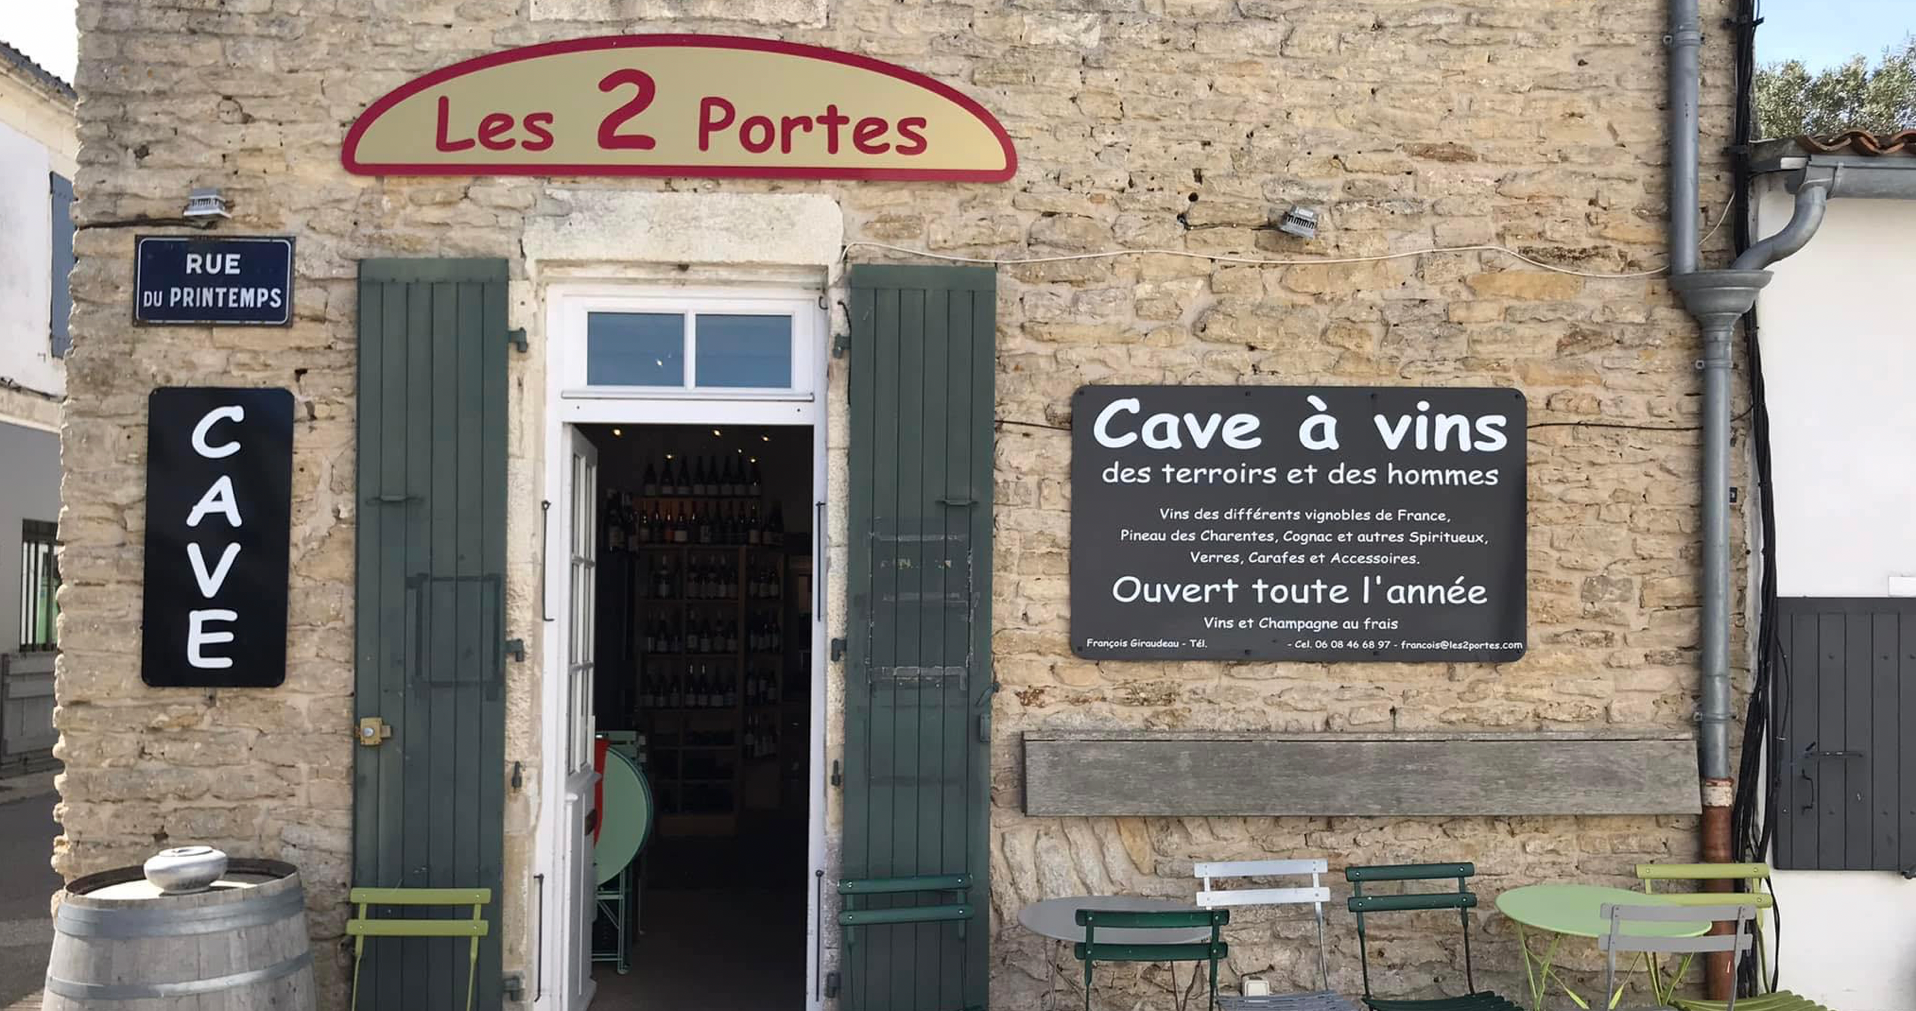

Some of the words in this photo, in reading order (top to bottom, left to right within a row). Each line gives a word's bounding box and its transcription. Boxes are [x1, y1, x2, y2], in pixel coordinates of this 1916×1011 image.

[435, 95, 554, 153] Les
[597, 68, 657, 151] 2
[698, 96, 928, 156] Portes
[186, 253, 241, 275] RUE
[143, 291, 163, 307] DU
[170, 287, 282, 308] PRINTEMPS
[1093, 397, 1262, 450] Cave
[1298, 394, 1340, 451] à
[1373, 400, 1508, 452] vins
[1102, 460, 1152, 484] des
[1161, 462, 1277, 484] terroirs
[1286, 464, 1318, 485] et
[1327, 461, 1377, 485] des
[1387, 462, 1499, 486] hommes
[1159, 507, 1190, 520] Vins
[1193, 507, 1220, 520] des
[1223, 507, 1301, 521] différents
[1304, 508, 1371, 524] vignobles
[1374, 508, 1394, 521] de
[1397, 508, 1451, 523] France,
[186, 405, 244, 669] CAVE
[1120, 528, 1167, 542] Pineau
[1170, 529, 1196, 542] des
[1200, 529, 1279, 544] Charentes,
[1282, 530, 1333, 546] Cognac
[1337, 531, 1354, 543] et
[1356, 531, 1405, 543] autres
[1408, 531, 1489, 546] Spiritueux,
[1190, 550, 1245, 565] Verres,
[1248, 550, 1306, 565] Carafes
[1309, 552, 1326, 564] et
[1330, 552, 1420, 565] Accessoires.
[1112, 575, 1240, 604] Ouvert
[1251, 578, 1350, 604] toute
[1363, 574, 1488, 605] l'année
[1203, 616, 1235, 629] Vins
[1237, 617, 1255, 629] et
[1258, 616, 1339, 633] Champagne
[1342, 619, 1359, 630] au
[1363, 616, 1399, 631] frais
[1086, 637, 1128, 650] François
[1129, 637, 1180, 648] Giraudeau
[1189, 638, 1208, 649] Tél.
[1294, 639, 1313, 649] Cel.
[1314, 639, 1329, 649] 06
[1330, 639, 1344, 649] 08
[1346, 639, 1360, 649] 46
[1361, 639, 1376, 650] 68
[1377, 639, 1391, 650] 97
[1400, 639, 1524, 652] francois@les2portes.com
